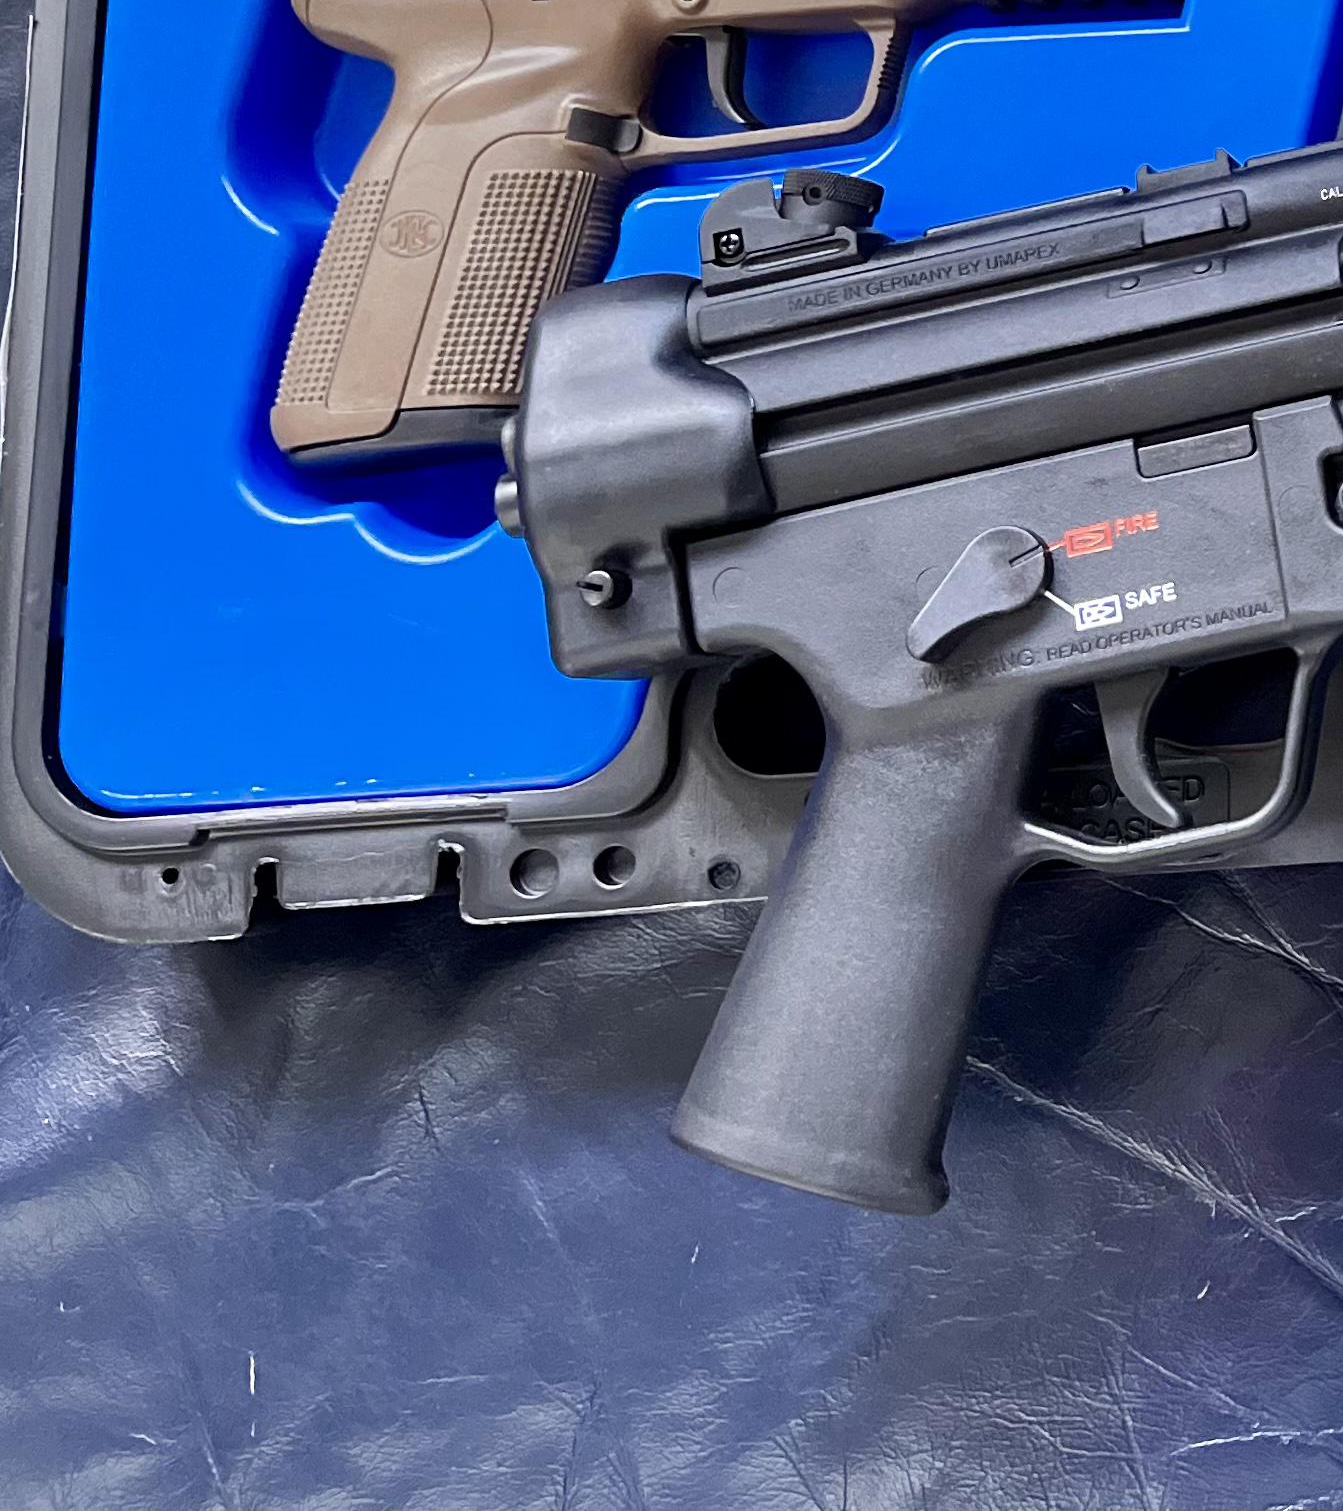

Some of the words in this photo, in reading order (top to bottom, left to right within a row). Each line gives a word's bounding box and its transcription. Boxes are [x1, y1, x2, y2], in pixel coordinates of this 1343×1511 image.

[787, 291, 838, 313] MADE
[843, 286, 861, 301] IN
[865, 266, 953, 297] GERMANY
[958, 259, 981, 278] BY
[1115, 510, 1160, 539] FIRE
[1125, 581, 1178, 611] SAFE
[1046, 639, 1092, 663] READ
[1095, 616, 1202, 650] OPERATOR'S
[1205, 601, 1275, 627] MANUAL
